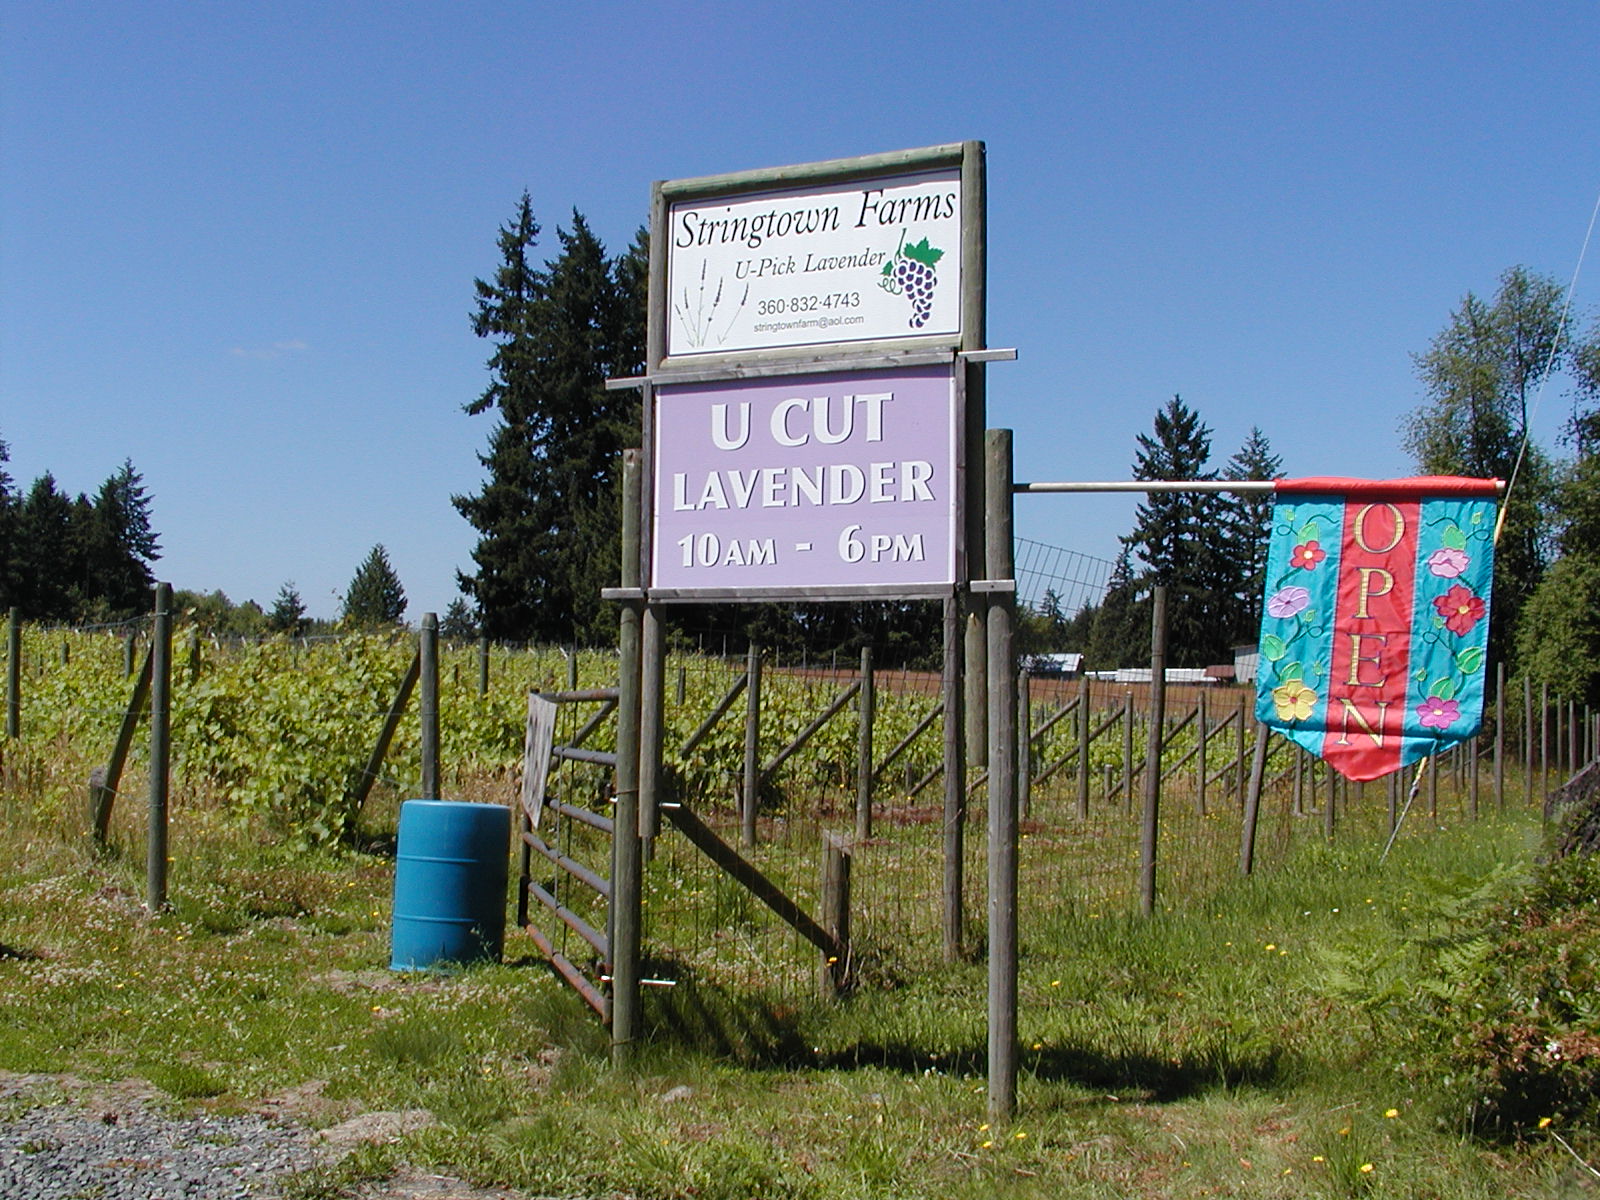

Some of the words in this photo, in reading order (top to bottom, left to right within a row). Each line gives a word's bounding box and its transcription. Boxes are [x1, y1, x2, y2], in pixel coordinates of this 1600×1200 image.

[676, 205, 840, 249] Stringtown
[854, 189, 957, 227] Farms
[735, 255, 796, 279] U-Pick
[803, 248, 886, 272] Lavender
[753, 314, 864, 333] stringtownfarm@aol.com
[711, 402, 751, 450] U
[770, 392, 894, 447] CUT
[673, 460, 936, 512] LAVENDER
[677, 532, 778, 568] 10AM
[1335, 502, 1406, 749] OPEN
